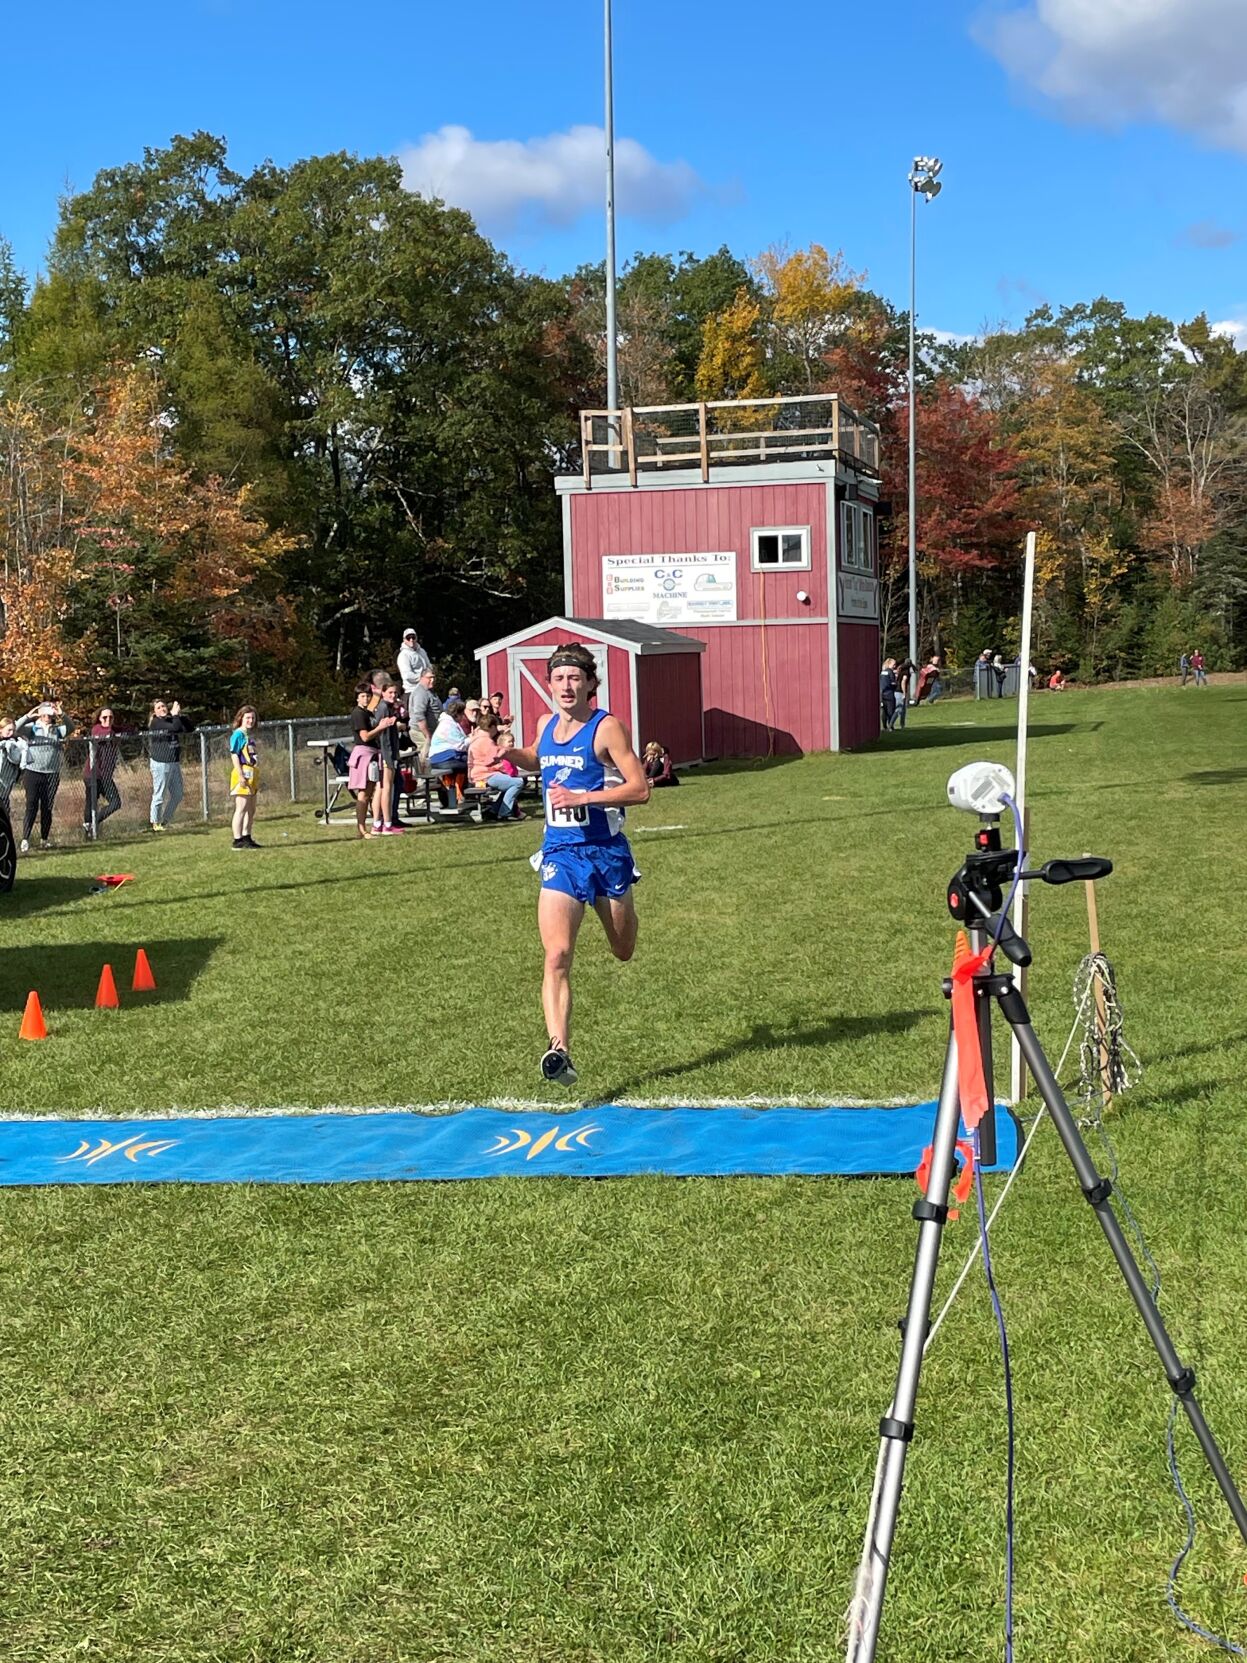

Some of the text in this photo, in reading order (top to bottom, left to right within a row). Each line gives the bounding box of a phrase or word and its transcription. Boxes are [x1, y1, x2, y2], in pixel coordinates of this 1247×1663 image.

[608, 553, 731, 566] Special Thanks To:
[540, 755, 584, 771] SUMNER
